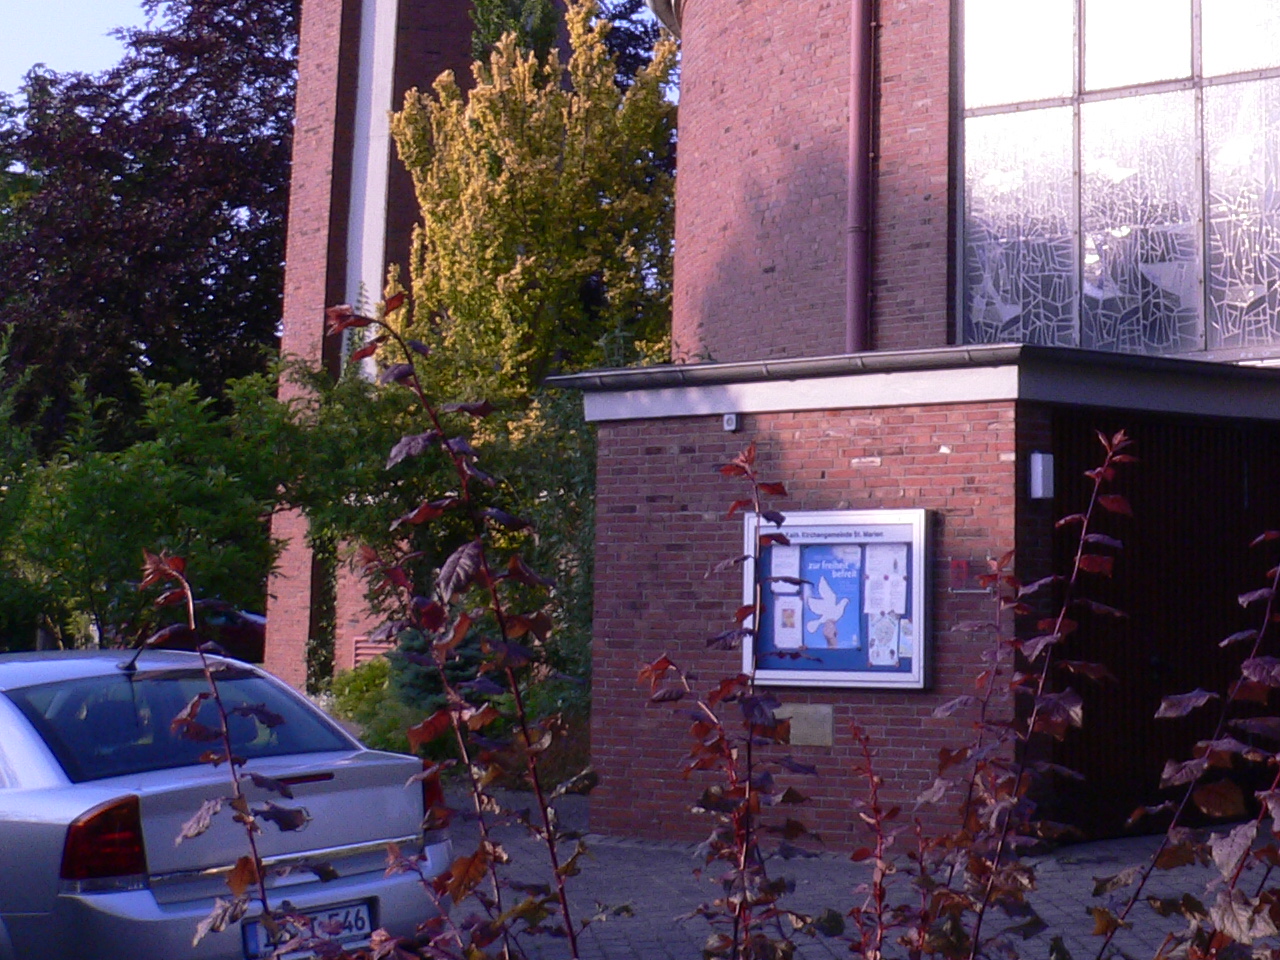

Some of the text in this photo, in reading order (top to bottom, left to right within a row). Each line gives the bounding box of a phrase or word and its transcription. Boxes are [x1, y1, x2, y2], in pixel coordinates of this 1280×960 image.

[808, 559, 849, 570] zur freiheit
[832, 569, 857, 578] befreit
